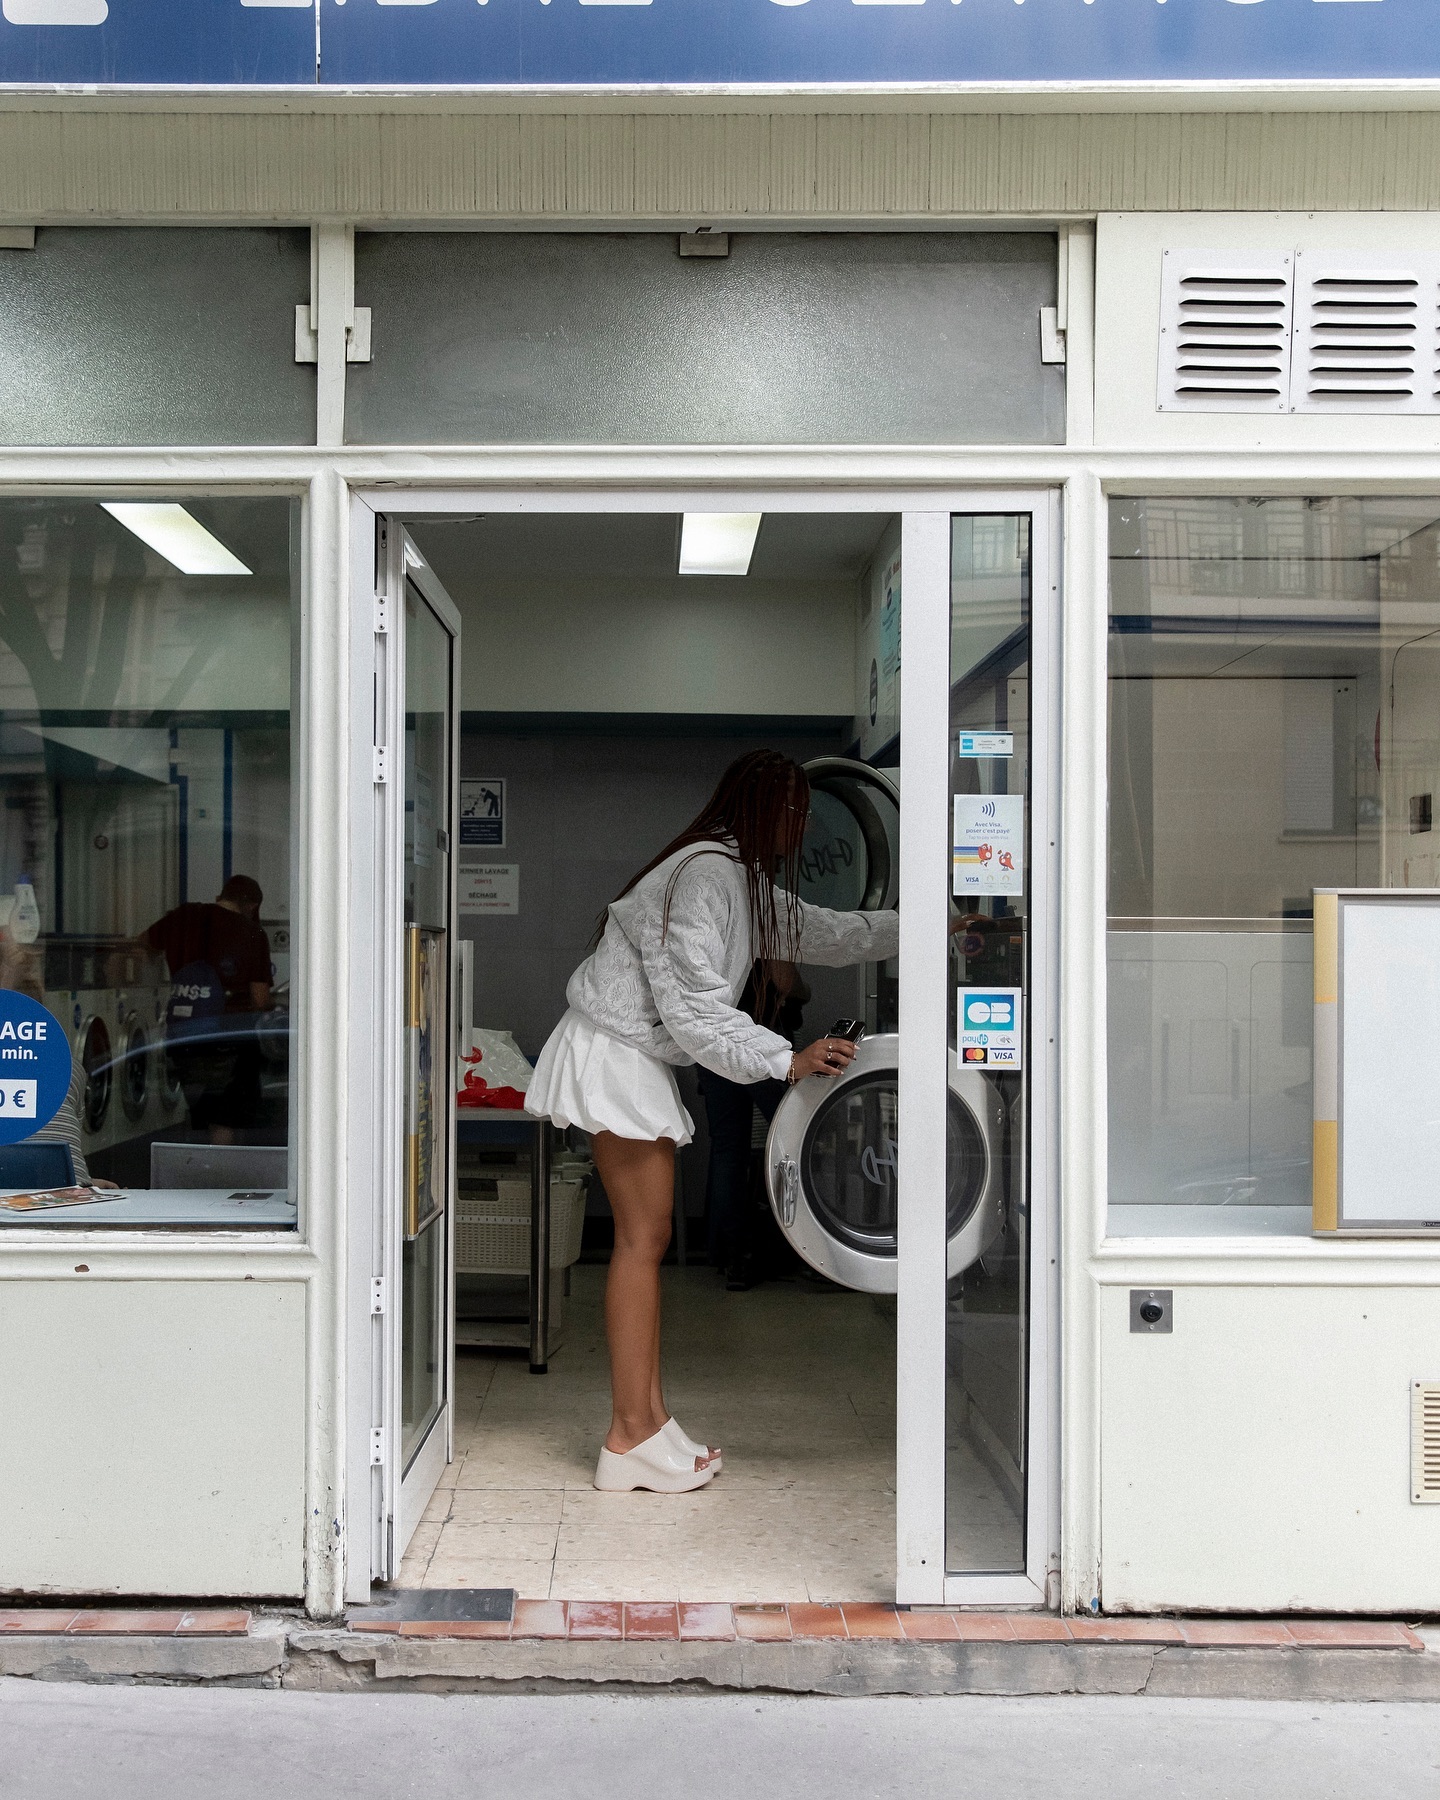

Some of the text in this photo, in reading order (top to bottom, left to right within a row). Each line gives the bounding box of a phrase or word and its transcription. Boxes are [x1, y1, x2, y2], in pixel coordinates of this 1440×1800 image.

[2, 1046, 38, 1060] min.
[994, 1052, 1013, 1060] VISA
[13, 1089, 26, 1108] €
